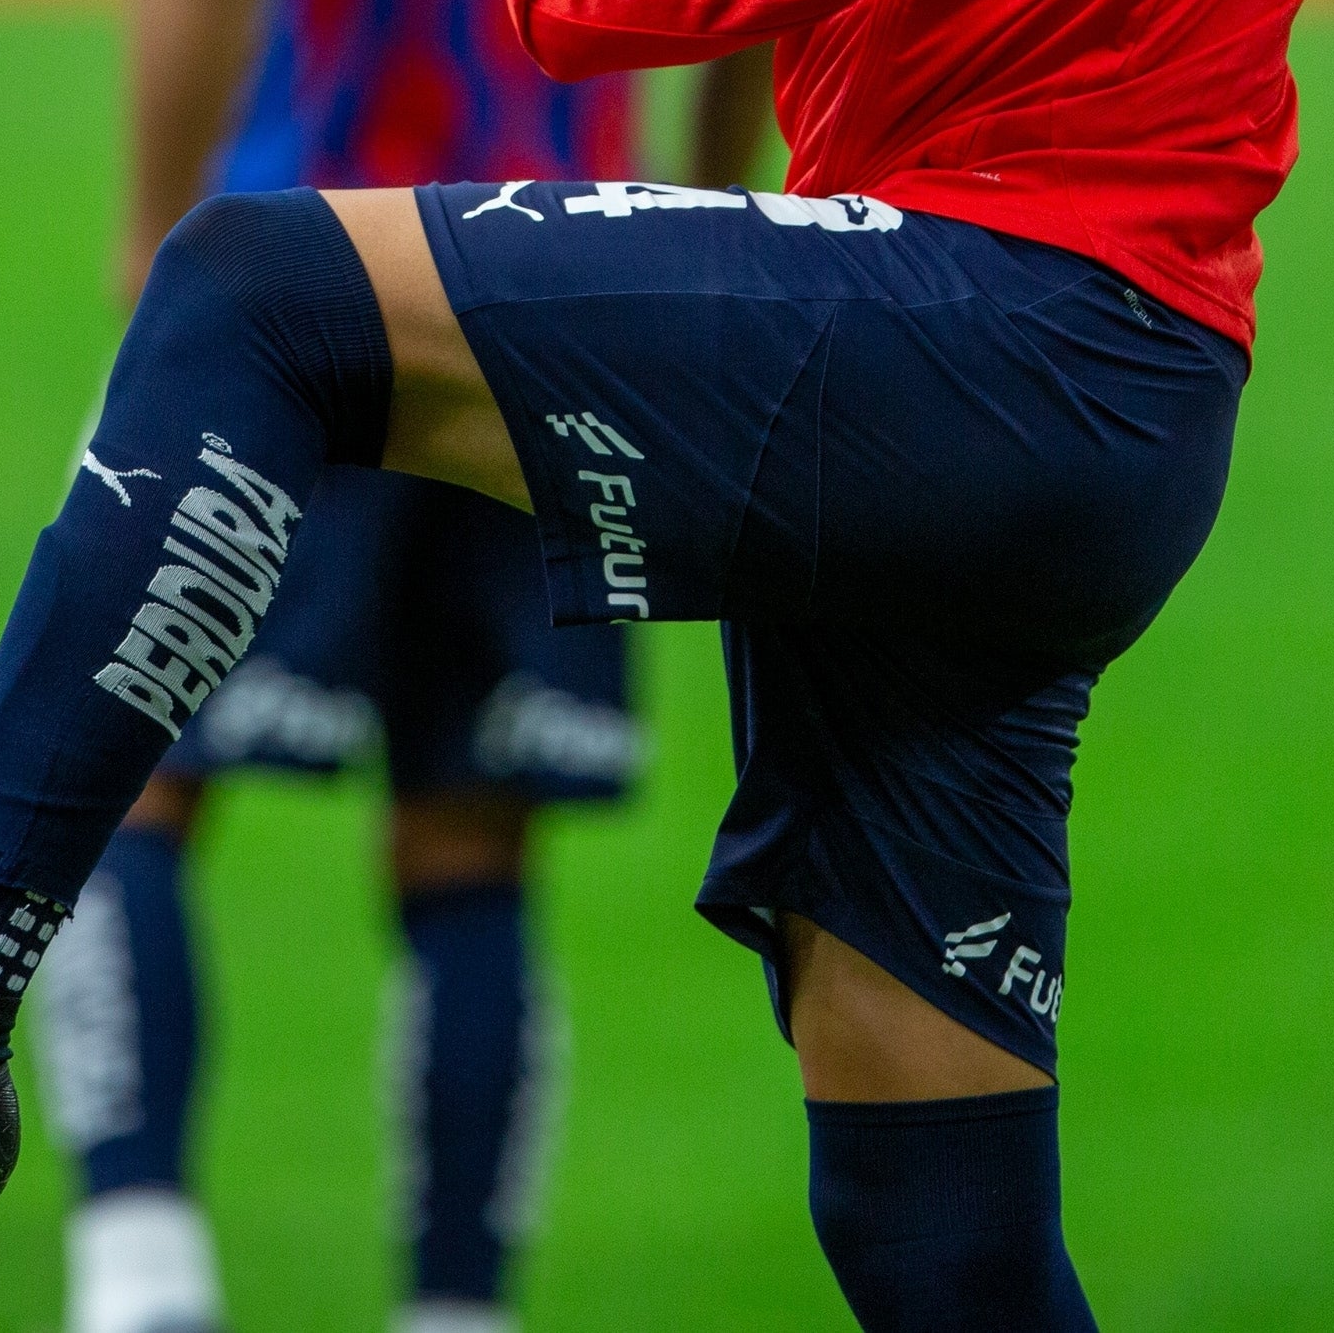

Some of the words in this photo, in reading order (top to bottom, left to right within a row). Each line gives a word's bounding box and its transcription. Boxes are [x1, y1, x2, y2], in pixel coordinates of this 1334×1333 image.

[1123, 288, 1152, 330] DRYCELL
[92, 446, 304, 742] PERDURA
[577, 469, 650, 625] Futur
